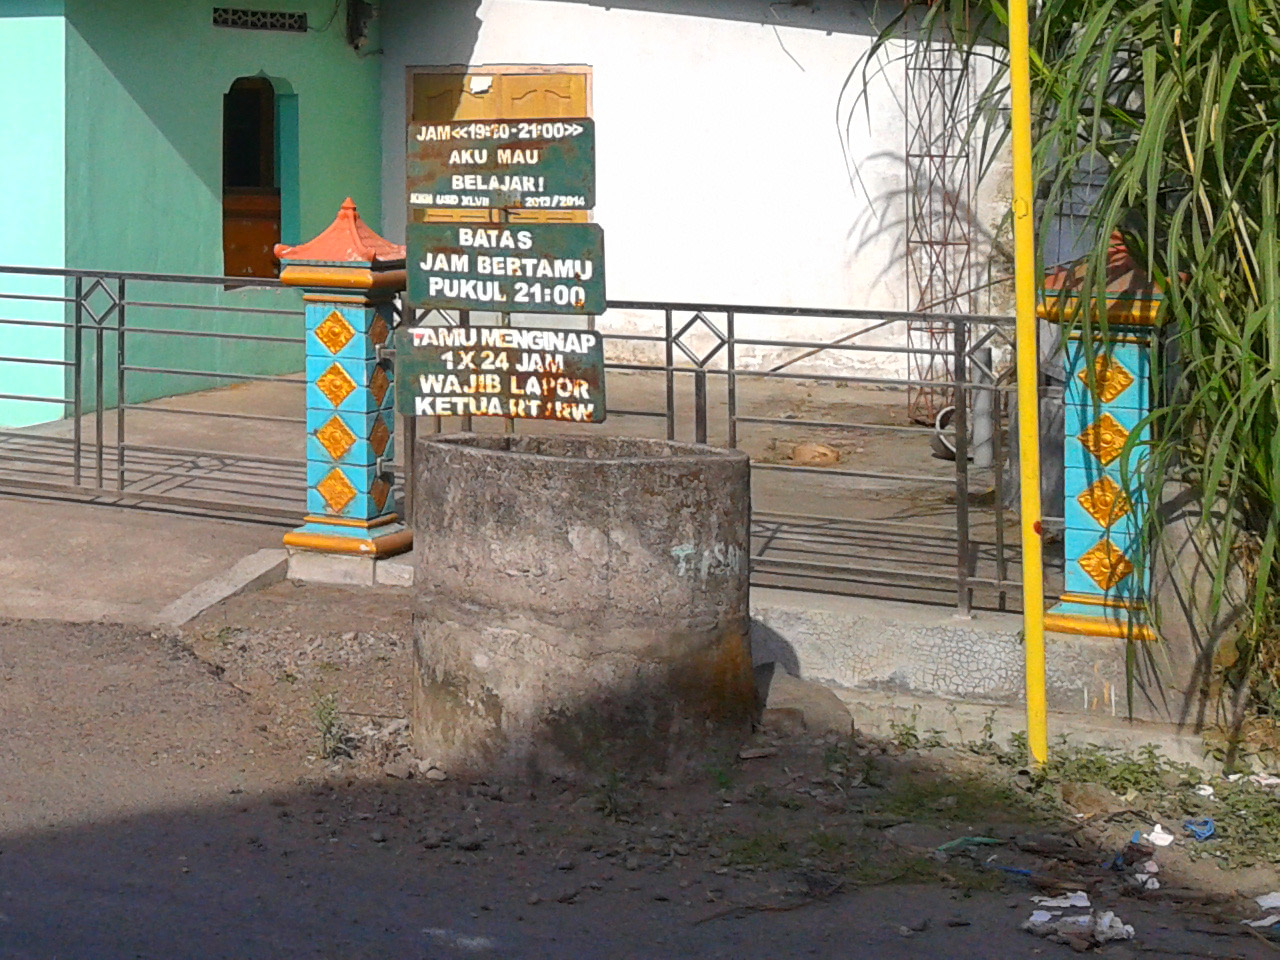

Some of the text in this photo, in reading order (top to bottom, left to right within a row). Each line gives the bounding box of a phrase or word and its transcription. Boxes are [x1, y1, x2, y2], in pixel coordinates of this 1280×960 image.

[416, 126, 451, 141] JAM
[449, 149, 539, 164] AKU MAU
[458, 228, 533, 249] BATAS
[420, 253, 593, 280] JAM BERTAMU
[429, 277, 586, 307] PUKUL 21:00
[408, 328, 596, 353] TAMU MENGINAP
[516, 353, 564, 373] JAM
[420, 374, 590, 399] WAJIB LAPOR
[415, 396, 503, 416] KETUA
